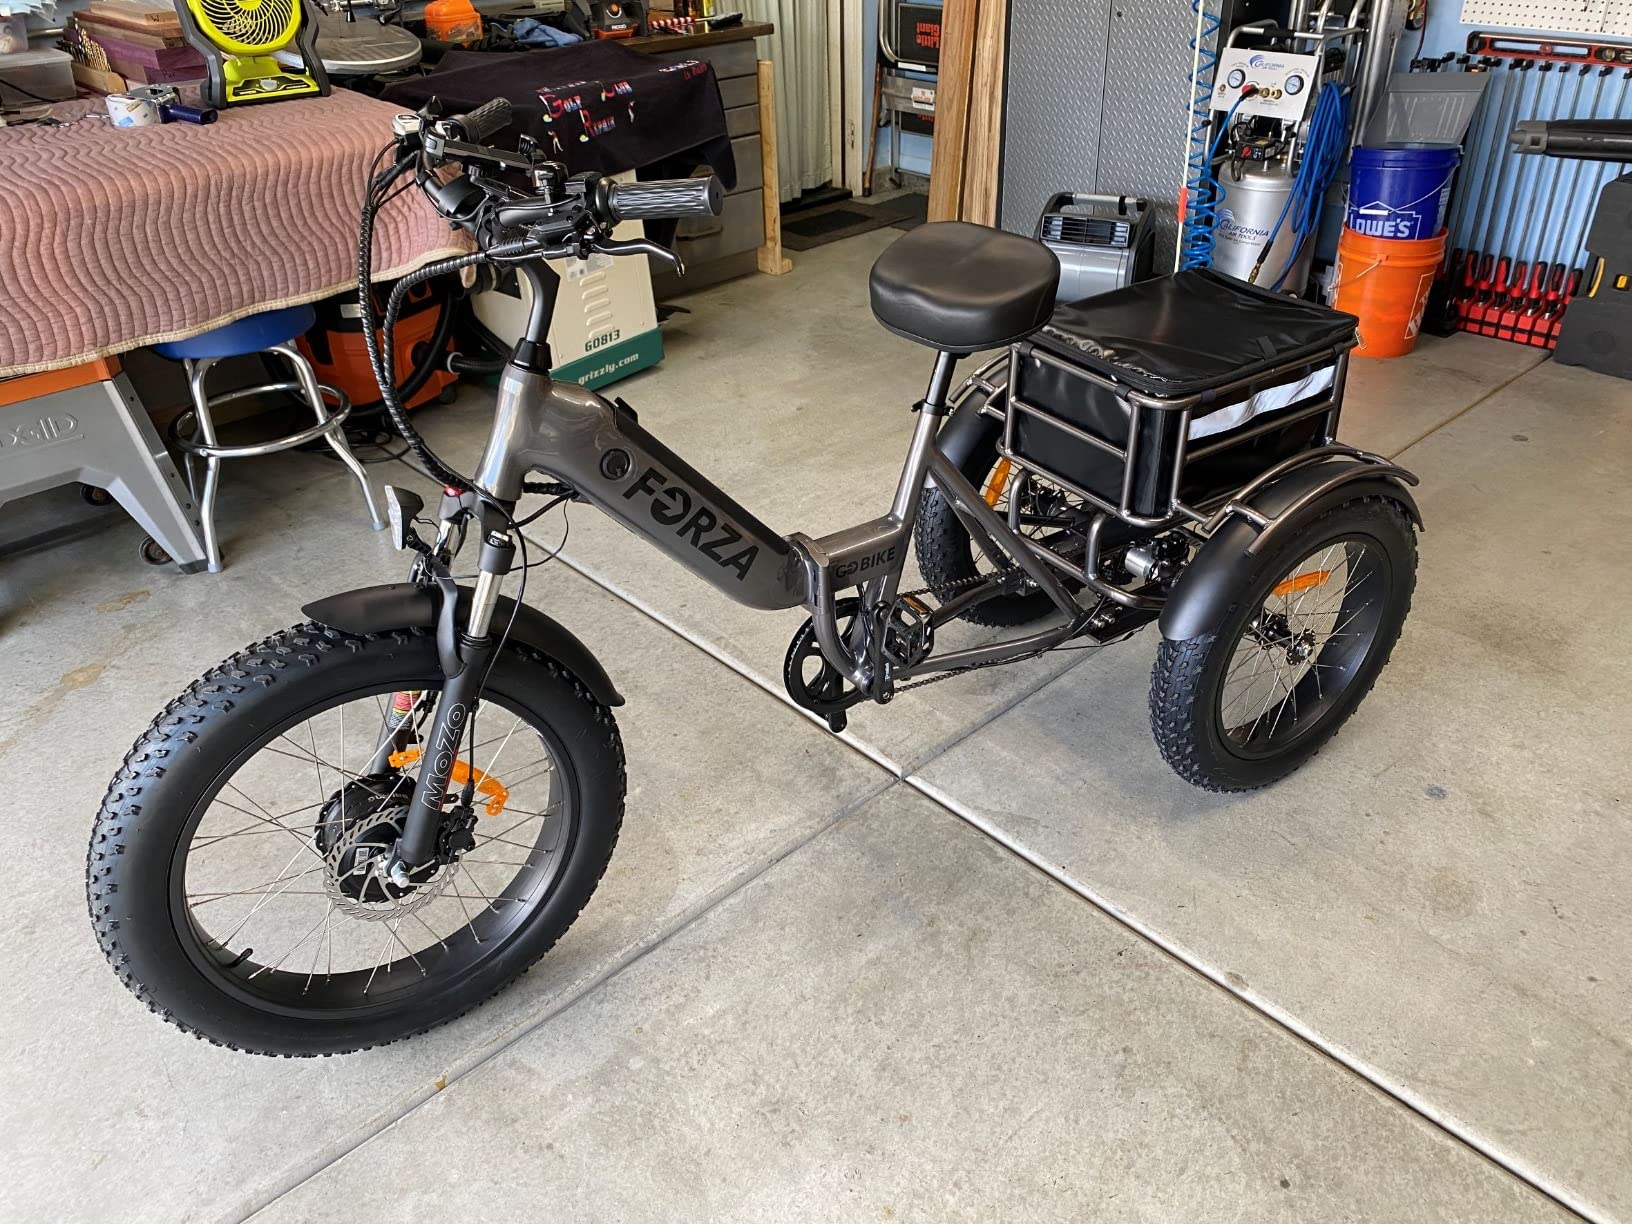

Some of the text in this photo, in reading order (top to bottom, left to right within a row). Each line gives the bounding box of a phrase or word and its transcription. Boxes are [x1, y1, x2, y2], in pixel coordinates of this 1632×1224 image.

[1220, 219, 1269, 237] CALIFORNIA
[578, 352, 640, 386] grizzly.com
[622, 466, 760, 582] FORZA
